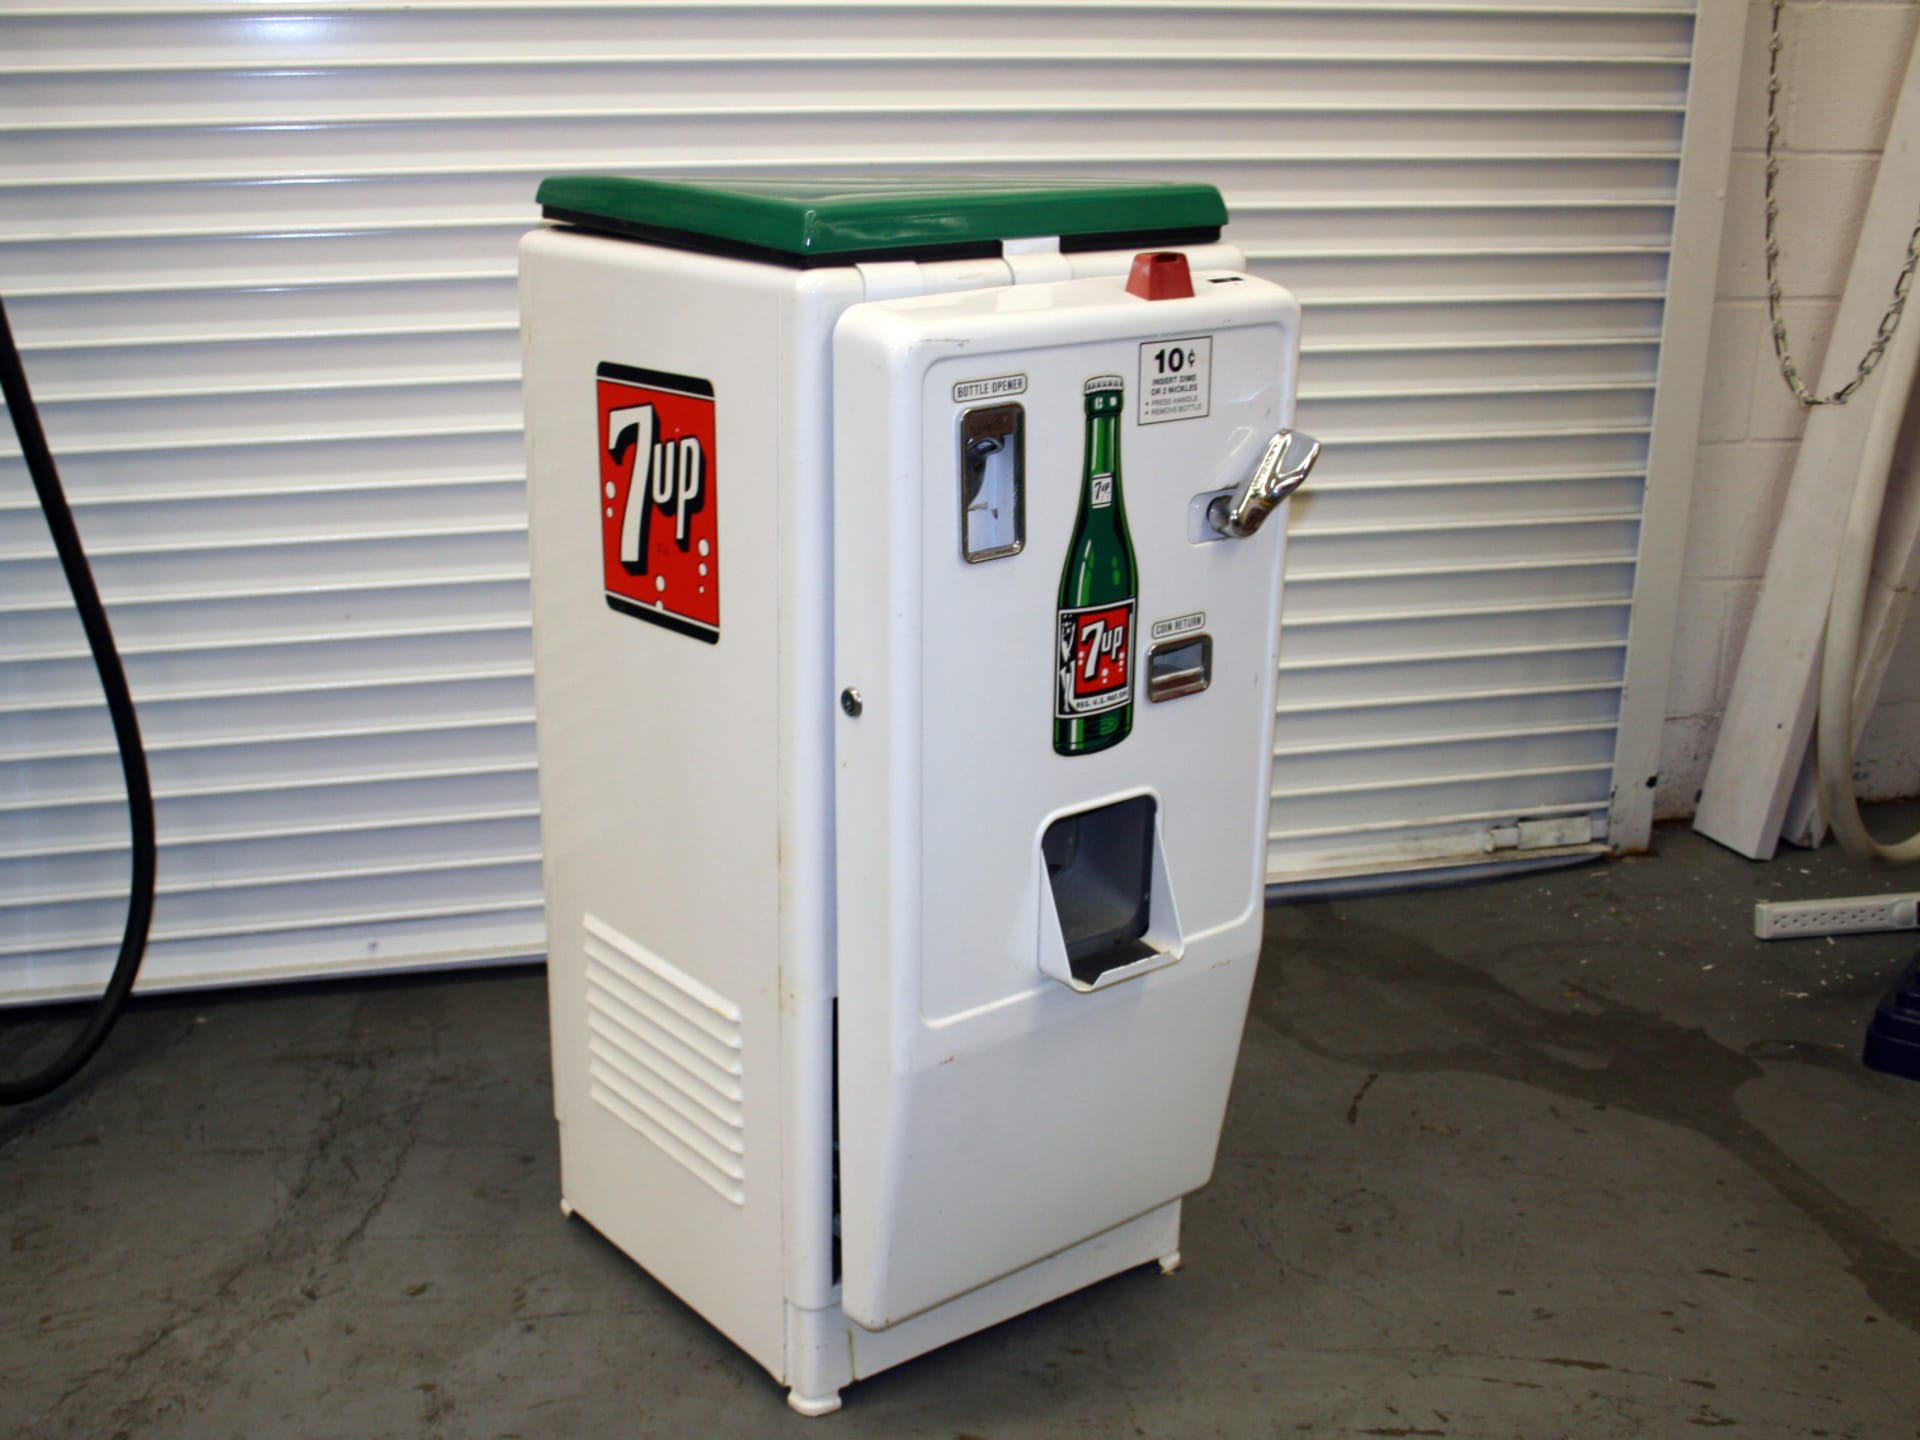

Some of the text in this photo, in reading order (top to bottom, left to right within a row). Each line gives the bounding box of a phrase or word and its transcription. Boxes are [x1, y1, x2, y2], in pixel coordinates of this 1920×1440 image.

[1152, 374, 1197, 386] INSERT DIME
[957, 378, 1023, 398] BOTTLE OPENER
[1151, 387, 1161, 397] OR
[1168, 384, 1198, 394] NICKLES
[1155, 615, 1202, 633] COIN RETURN
